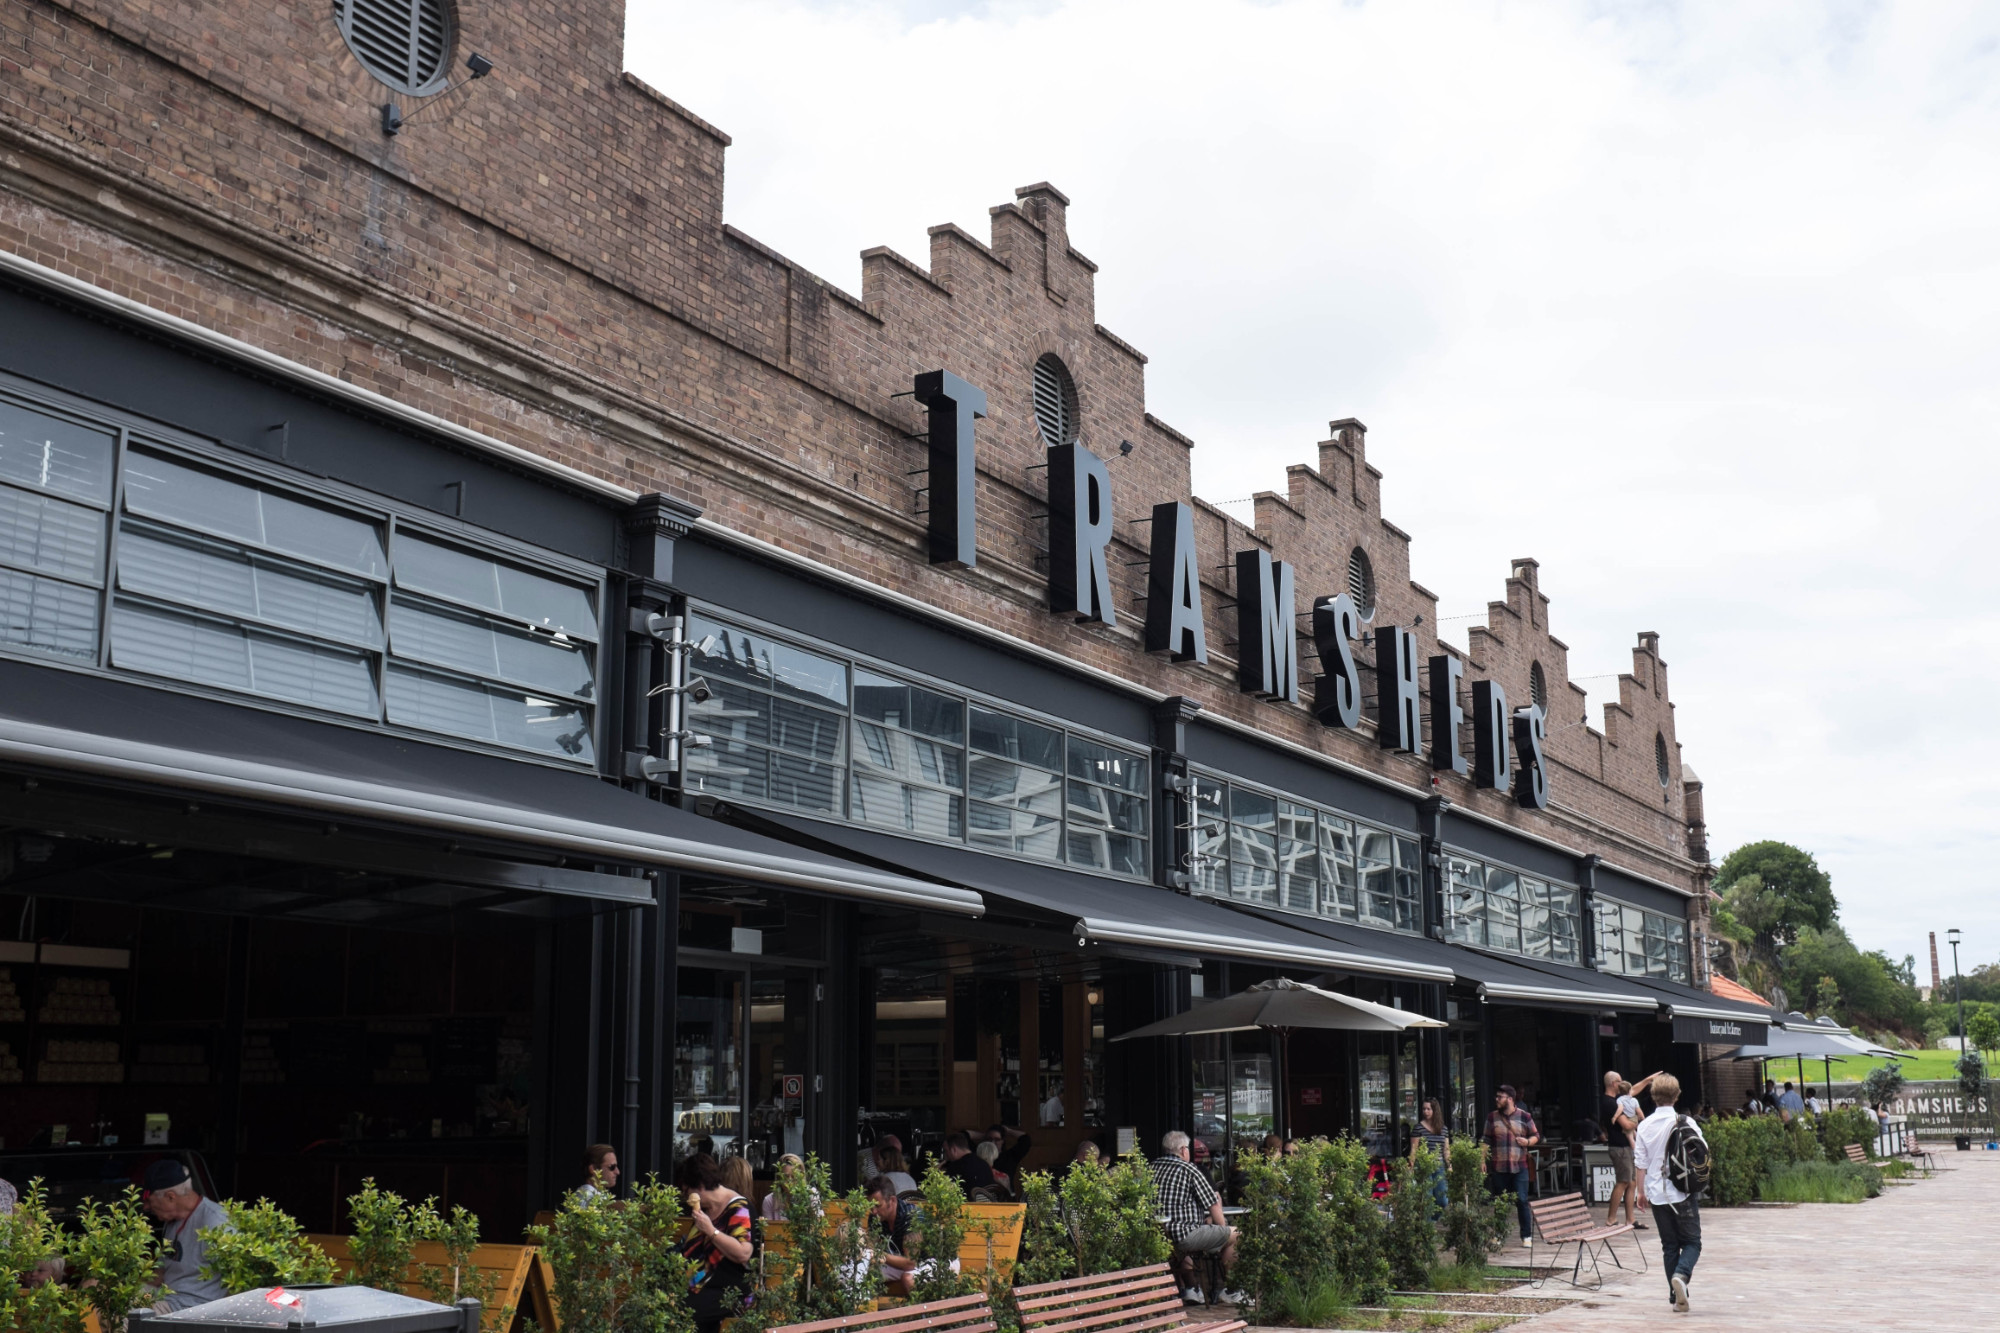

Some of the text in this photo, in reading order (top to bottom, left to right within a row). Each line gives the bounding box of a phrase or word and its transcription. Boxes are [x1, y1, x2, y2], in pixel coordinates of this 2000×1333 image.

[914, 369, 1548, 809] TRAMSHEDS
[1887, 1097, 1988, 1115] RAMSHEDS
[1931, 1116, 1951, 1125] 1904
